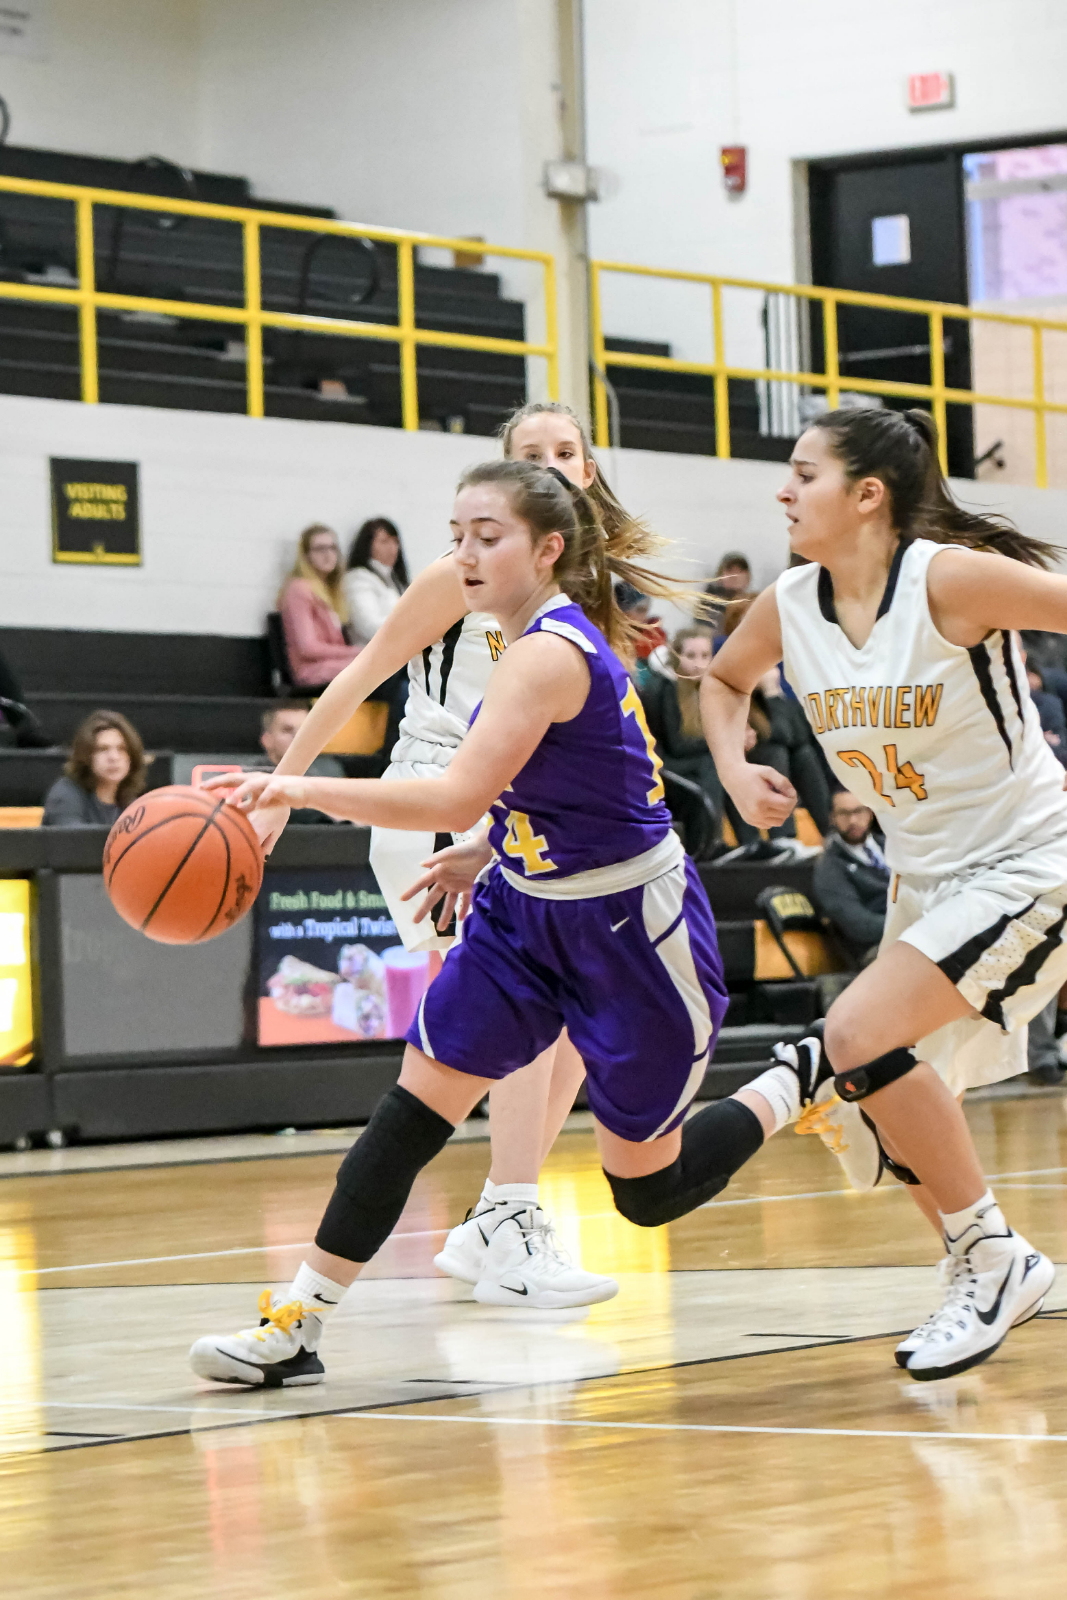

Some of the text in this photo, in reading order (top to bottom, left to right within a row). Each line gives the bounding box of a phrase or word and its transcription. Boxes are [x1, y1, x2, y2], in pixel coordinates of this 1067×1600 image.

[65, 481, 128, 502] VISITING
[68, 500, 127, 520] ADULTS
[803, 683, 944, 735] ORTHVIEW
[836, 743, 929, 808] 24
[269, 889, 309, 912] Fresh
[310, 889, 343, 910] Food
[304, 916, 358, 943] Tropical
